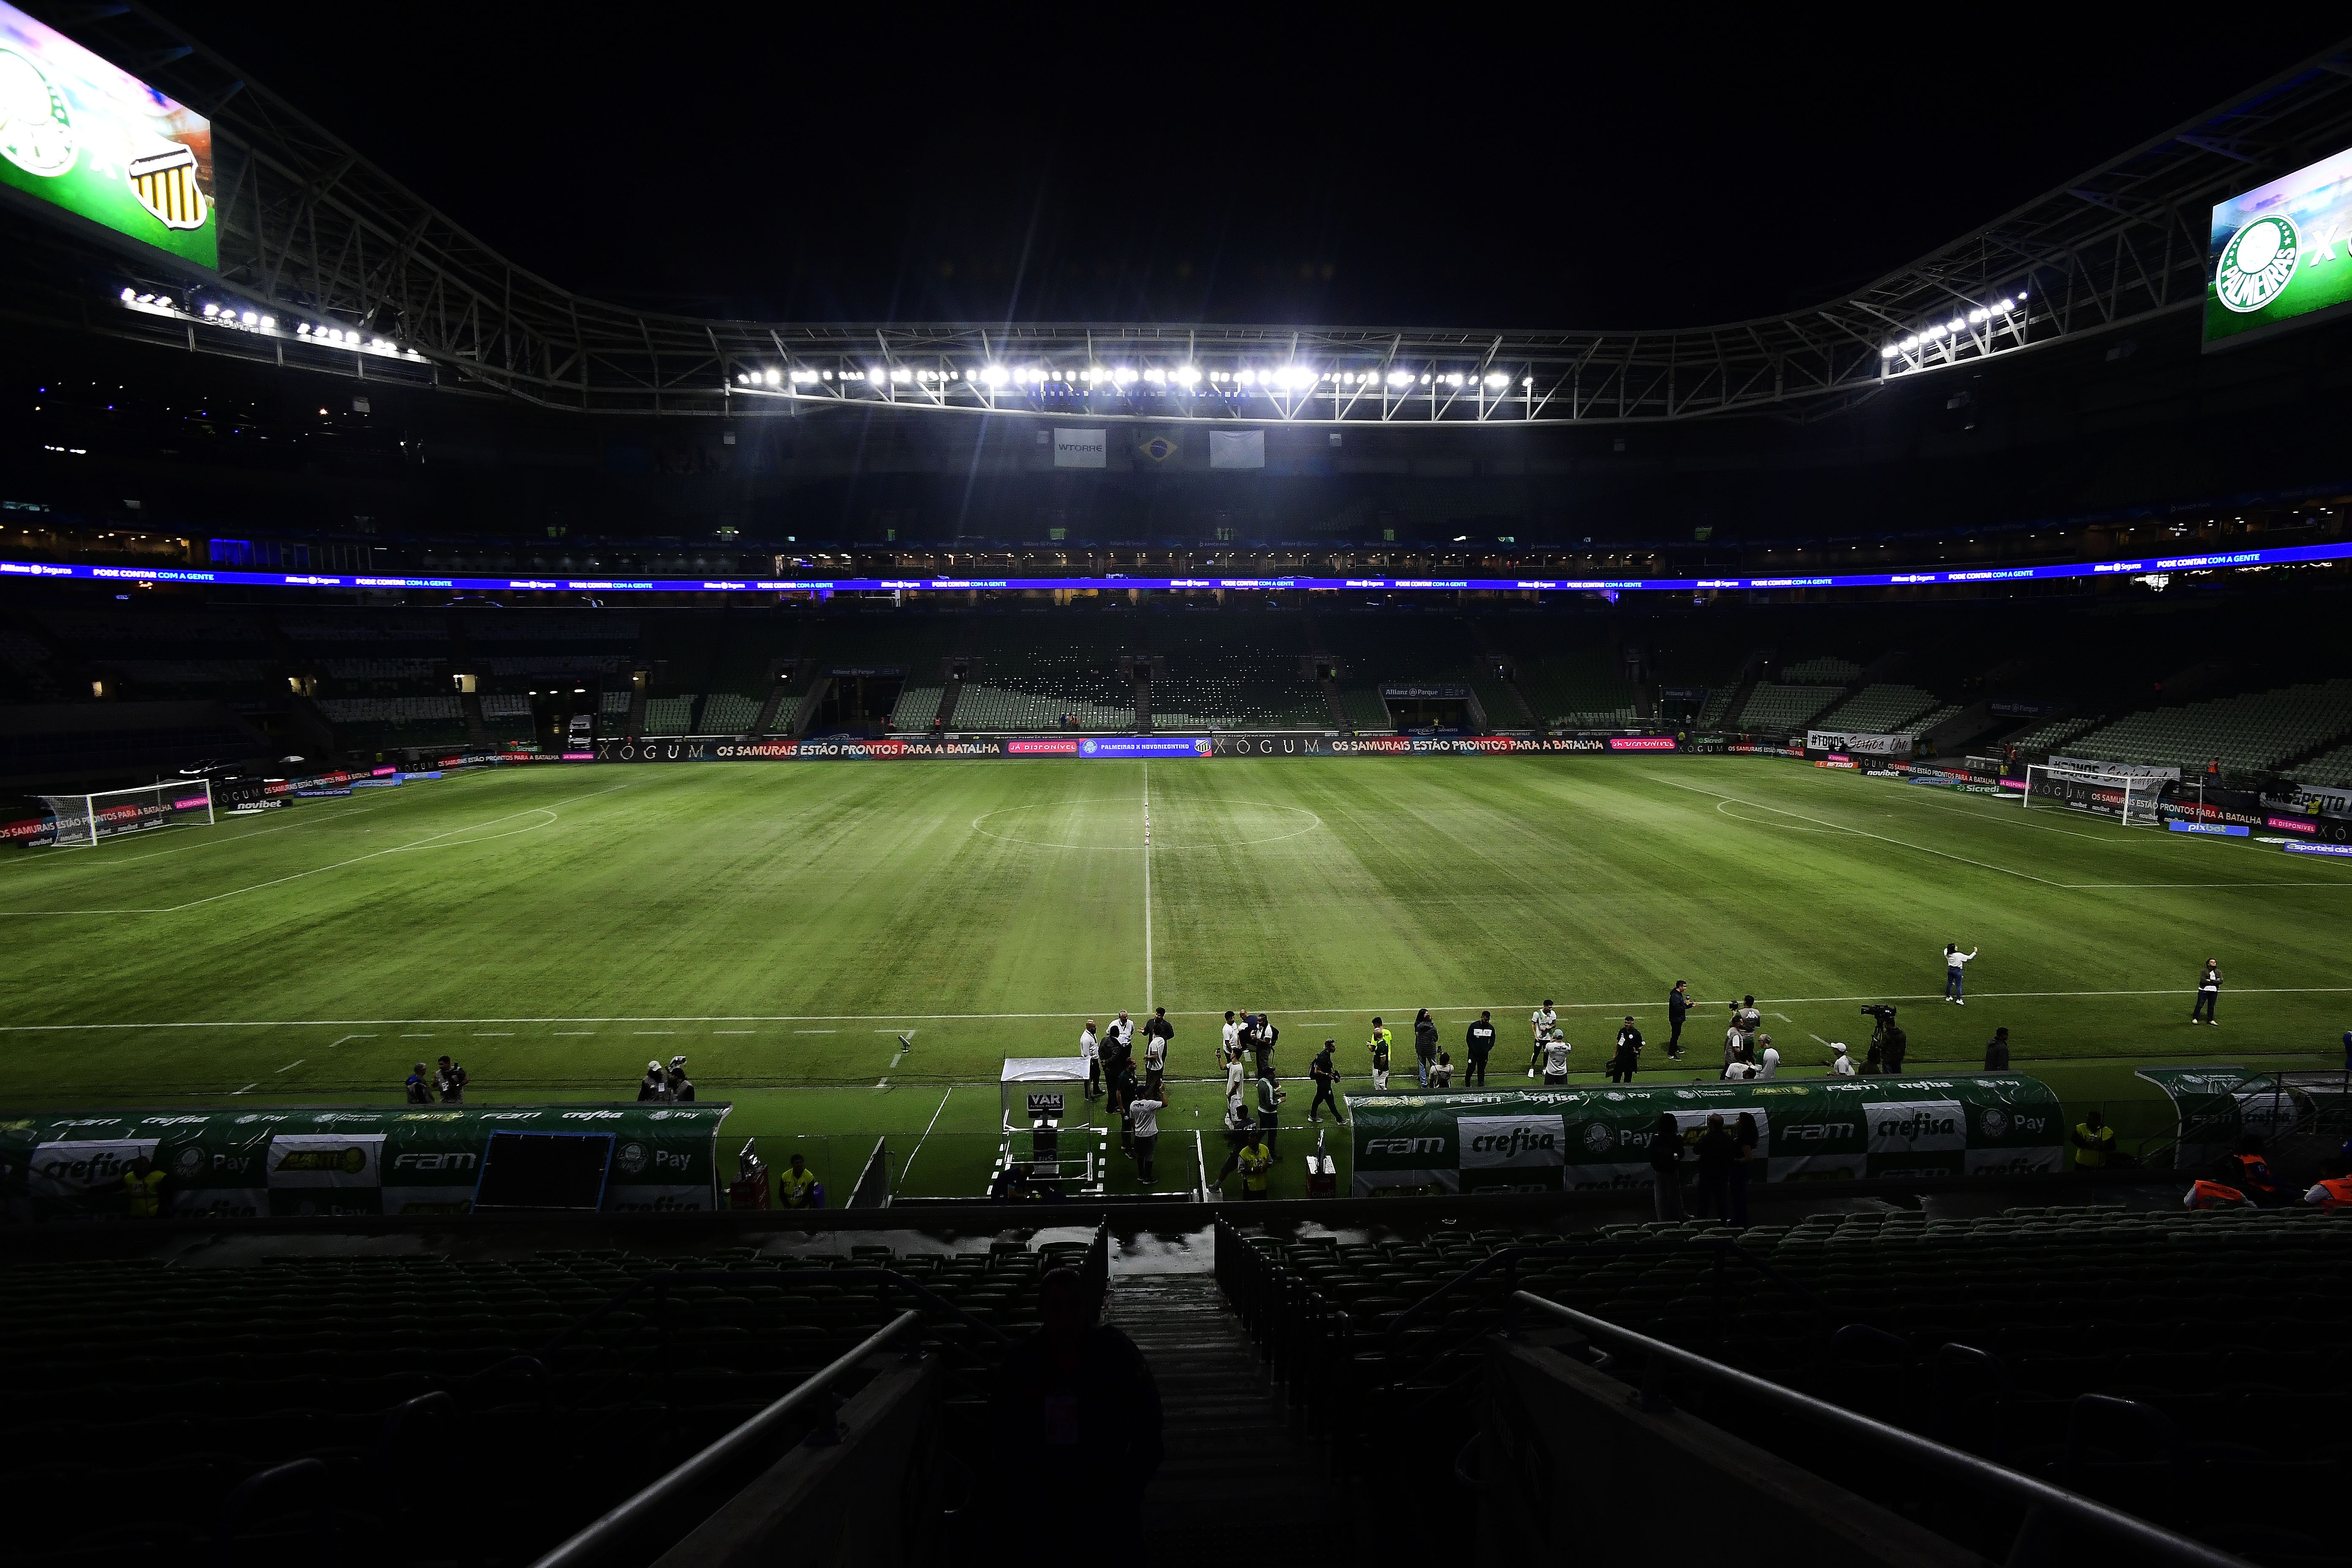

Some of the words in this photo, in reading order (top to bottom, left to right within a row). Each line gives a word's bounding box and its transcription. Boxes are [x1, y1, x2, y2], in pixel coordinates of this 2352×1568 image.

[2221, 247, 2296, 306] PALMEIRAS
[2234, 554, 2260, 562] GENTE
[43, 566, 72, 574] Seguros
[597, 742, 704, 760] XÓGUM
[716, 746, 734, 756] OS
[736, 745, 798, 756] SAMURAIS
[800, 742, 838, 755] ESTÃO
[841, 744, 898, 755] PRONTOS
[901, 744, 932, 754] PARA
[935, 744, 944, 754] A
[947, 743, 1000, 754] BATALHA
[1214, 737, 1319, 754] XÓGUM
[1332, 741, 1349, 751] OS
[1351, 741, 1411, 751] SAMURAIS
[1413, 738, 1450, 751] ESTÃO
[1452, 740, 1507, 750] PRONTOS
[1509, 740, 1540, 750] PARA
[1543, 740, 1552, 750] A
[1553, 740, 1604, 750] BATALHA
[1933, 770, 1955, 779] PRONTOS
[237, 800, 282, 809] novibet
[2102, 795, 2135, 806] SAMURIS
[2160, 803, 2194, 815] PRONTOS
[2226, 813, 2262, 825] BATALHA
[12, 823, 55, 837] SAMURAIS
[2188, 823, 2226, 833] pixbet
[2278, 821, 2314, 832] DISPONÍVEL
[1030, 1094, 1061, 1105] VAR
[674, 1111, 700, 1120] Pay
[1877, 1112, 1955, 1142] crefisa
[2014, 1114, 2046, 1134] Pay
[1472, 1127, 1555, 1158] crefisa
[1620, 1130, 1653, 1149] Pay
[213, 1154, 251, 1176] Pay
[656, 1150, 691, 1171] Pay
